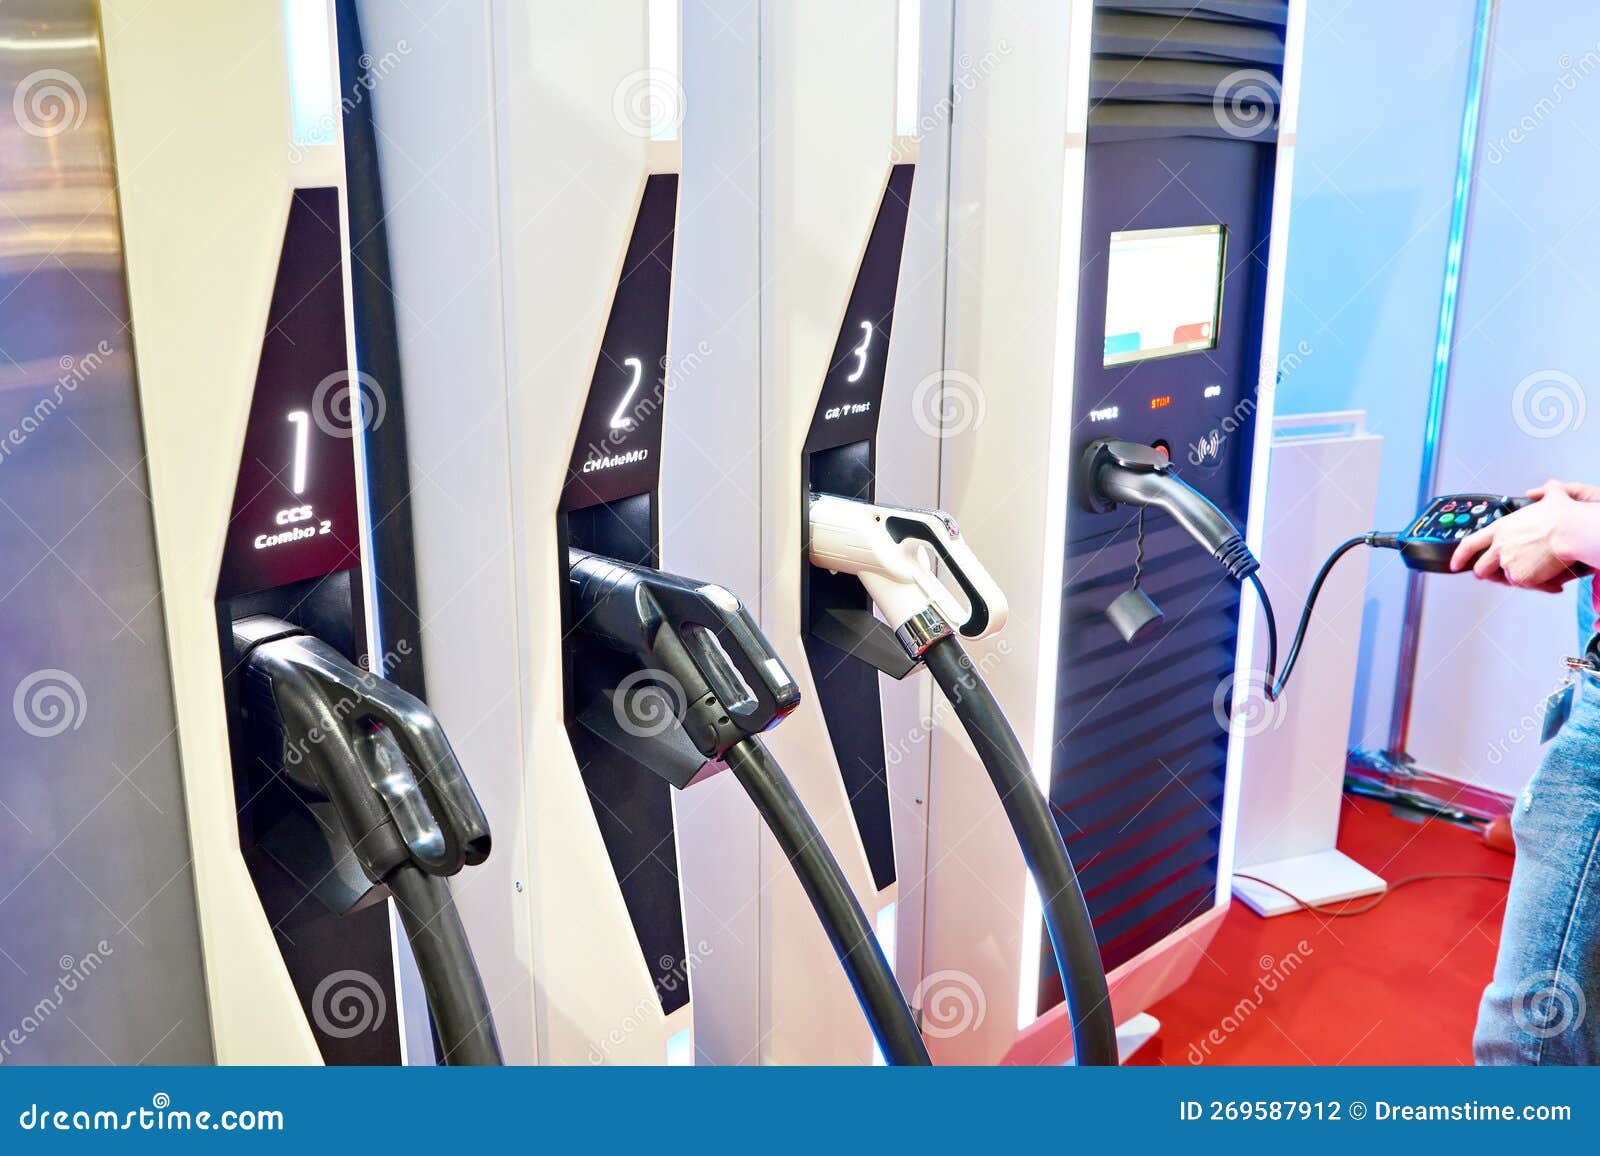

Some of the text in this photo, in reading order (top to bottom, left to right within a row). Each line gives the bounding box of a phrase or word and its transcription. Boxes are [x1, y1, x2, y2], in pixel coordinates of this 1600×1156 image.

[848, 321, 873, 382] 3
[610, 357, 642, 428] 2
[852, 402, 871, 414] fast
[287, 411, 309, 494] 1
[583, 449, 649, 473] CHAdeMO
[276, 505, 313, 525] CCS
[254, 520, 332, 549] Combo 2
